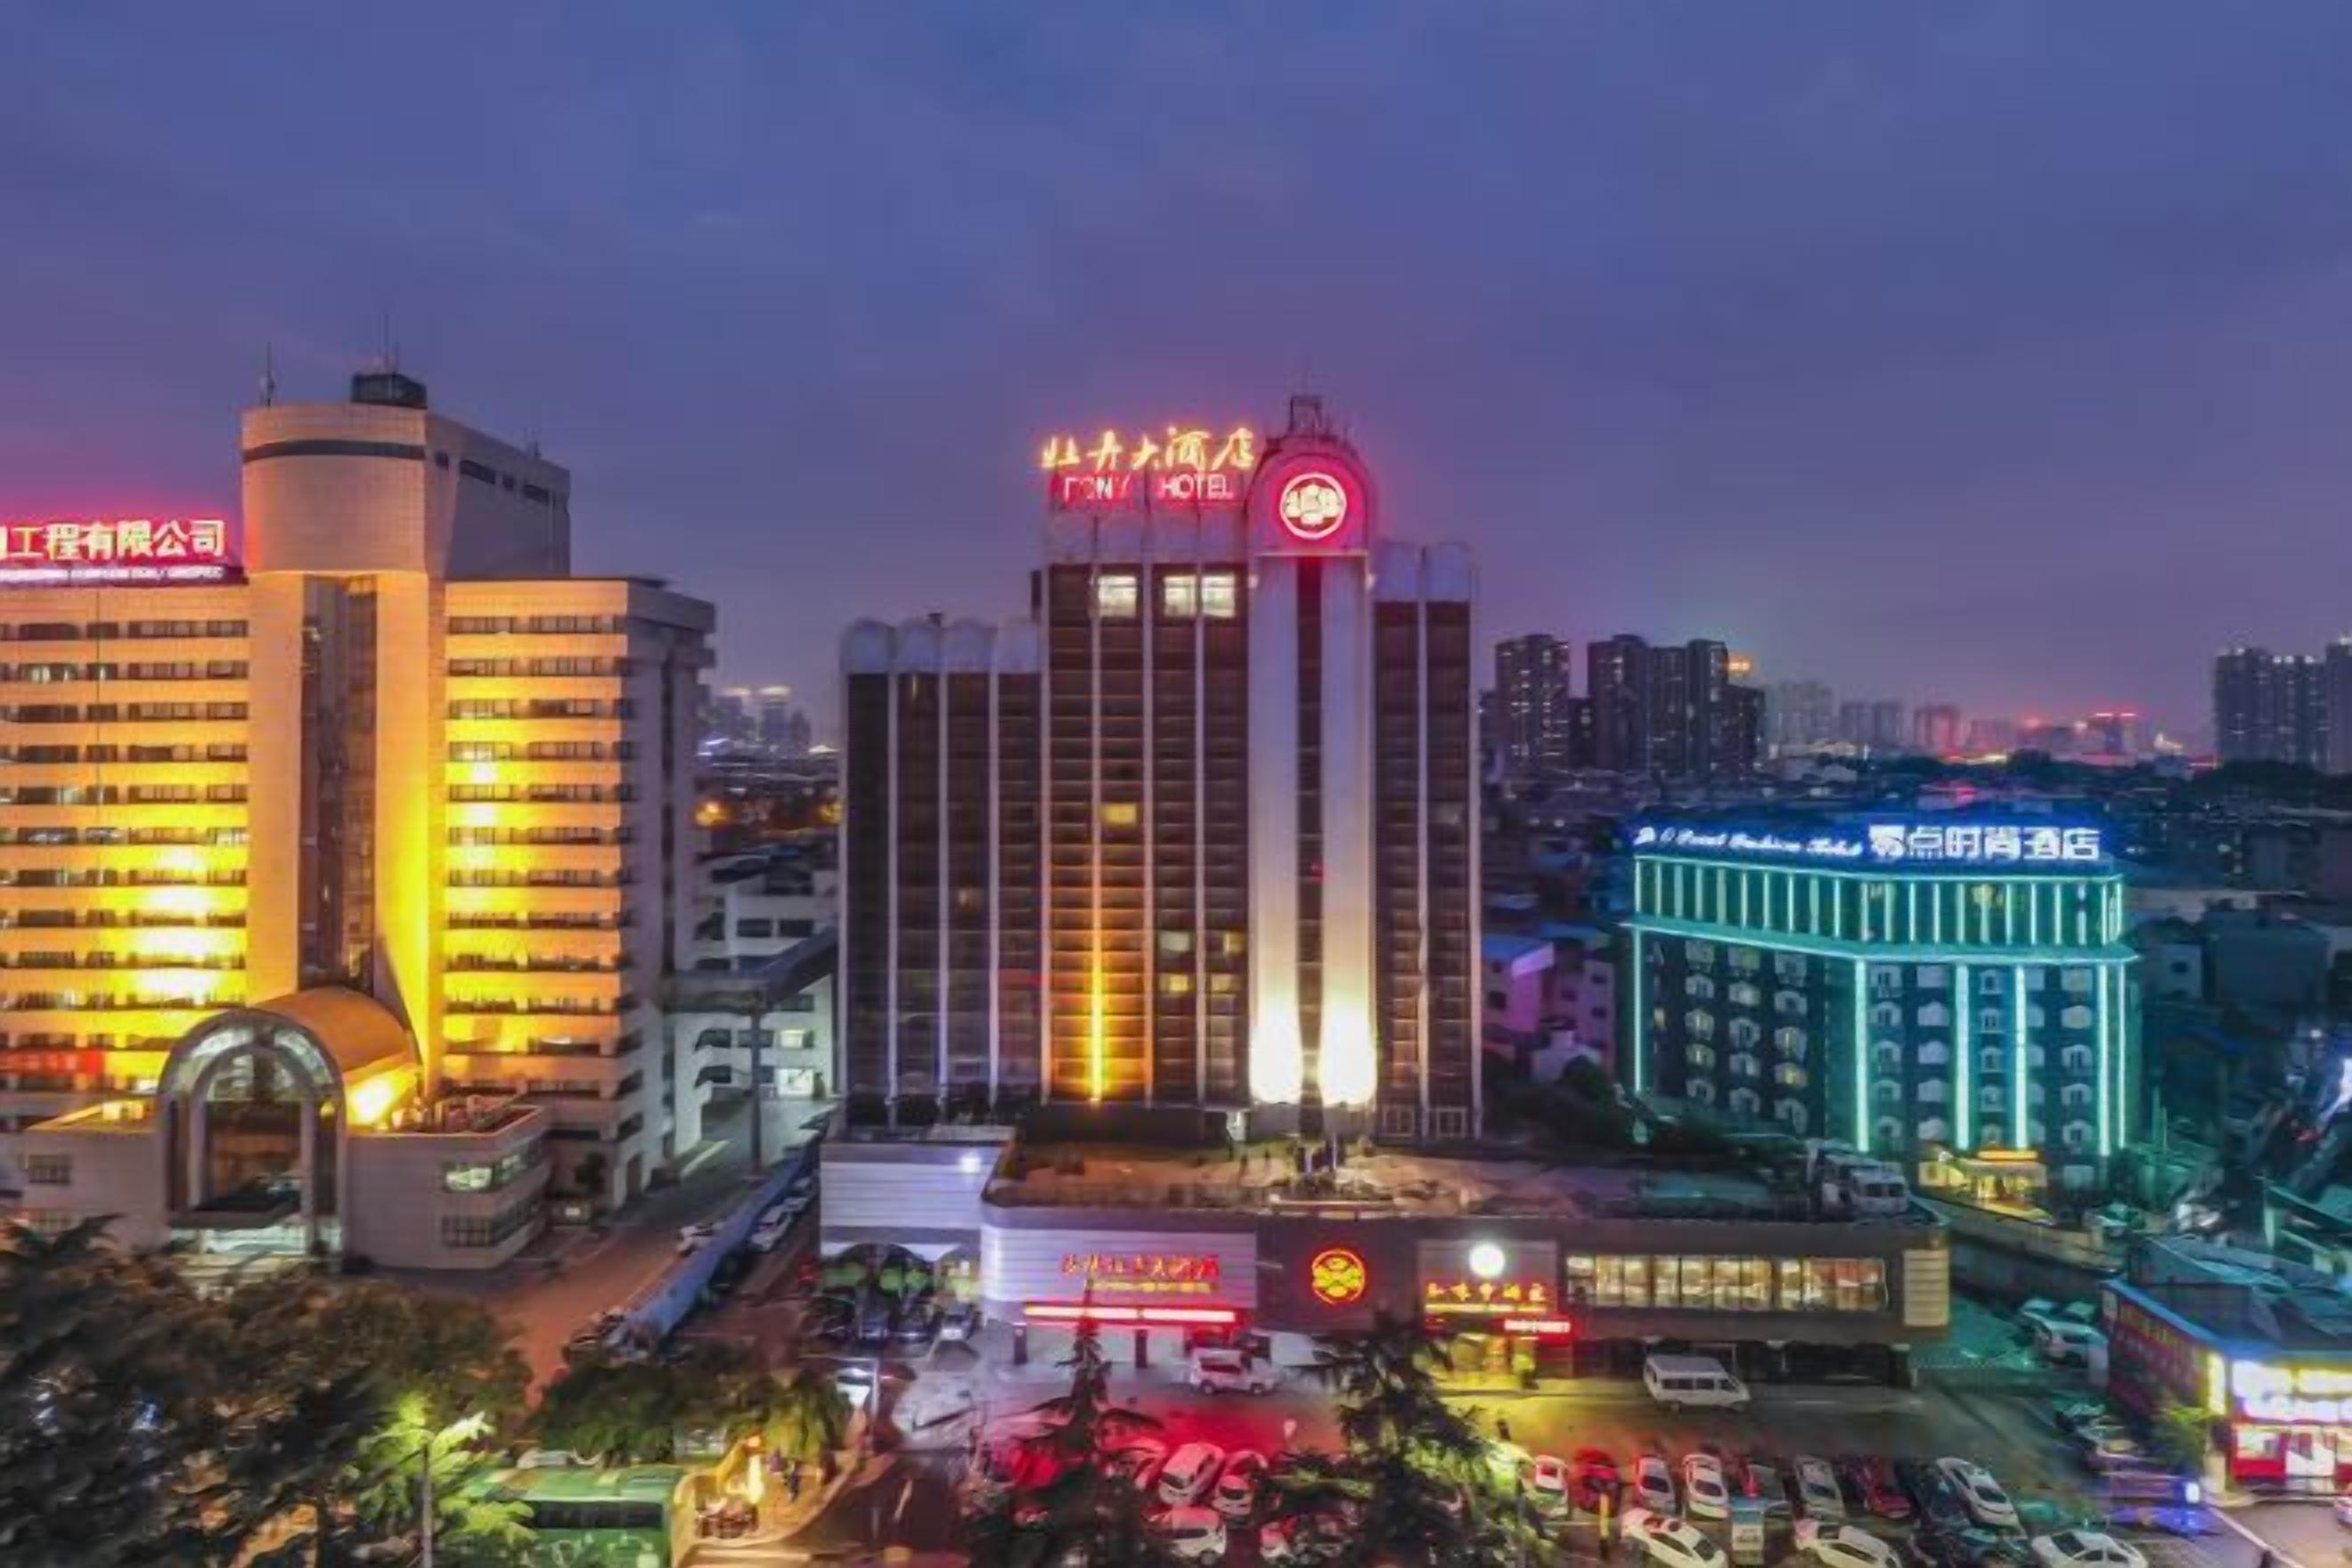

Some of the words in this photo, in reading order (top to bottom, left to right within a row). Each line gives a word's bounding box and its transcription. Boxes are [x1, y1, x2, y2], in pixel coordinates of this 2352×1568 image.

[1158, 473, 1235, 500] HOTEL
[0, 520, 225, 560] 工程有限公司
